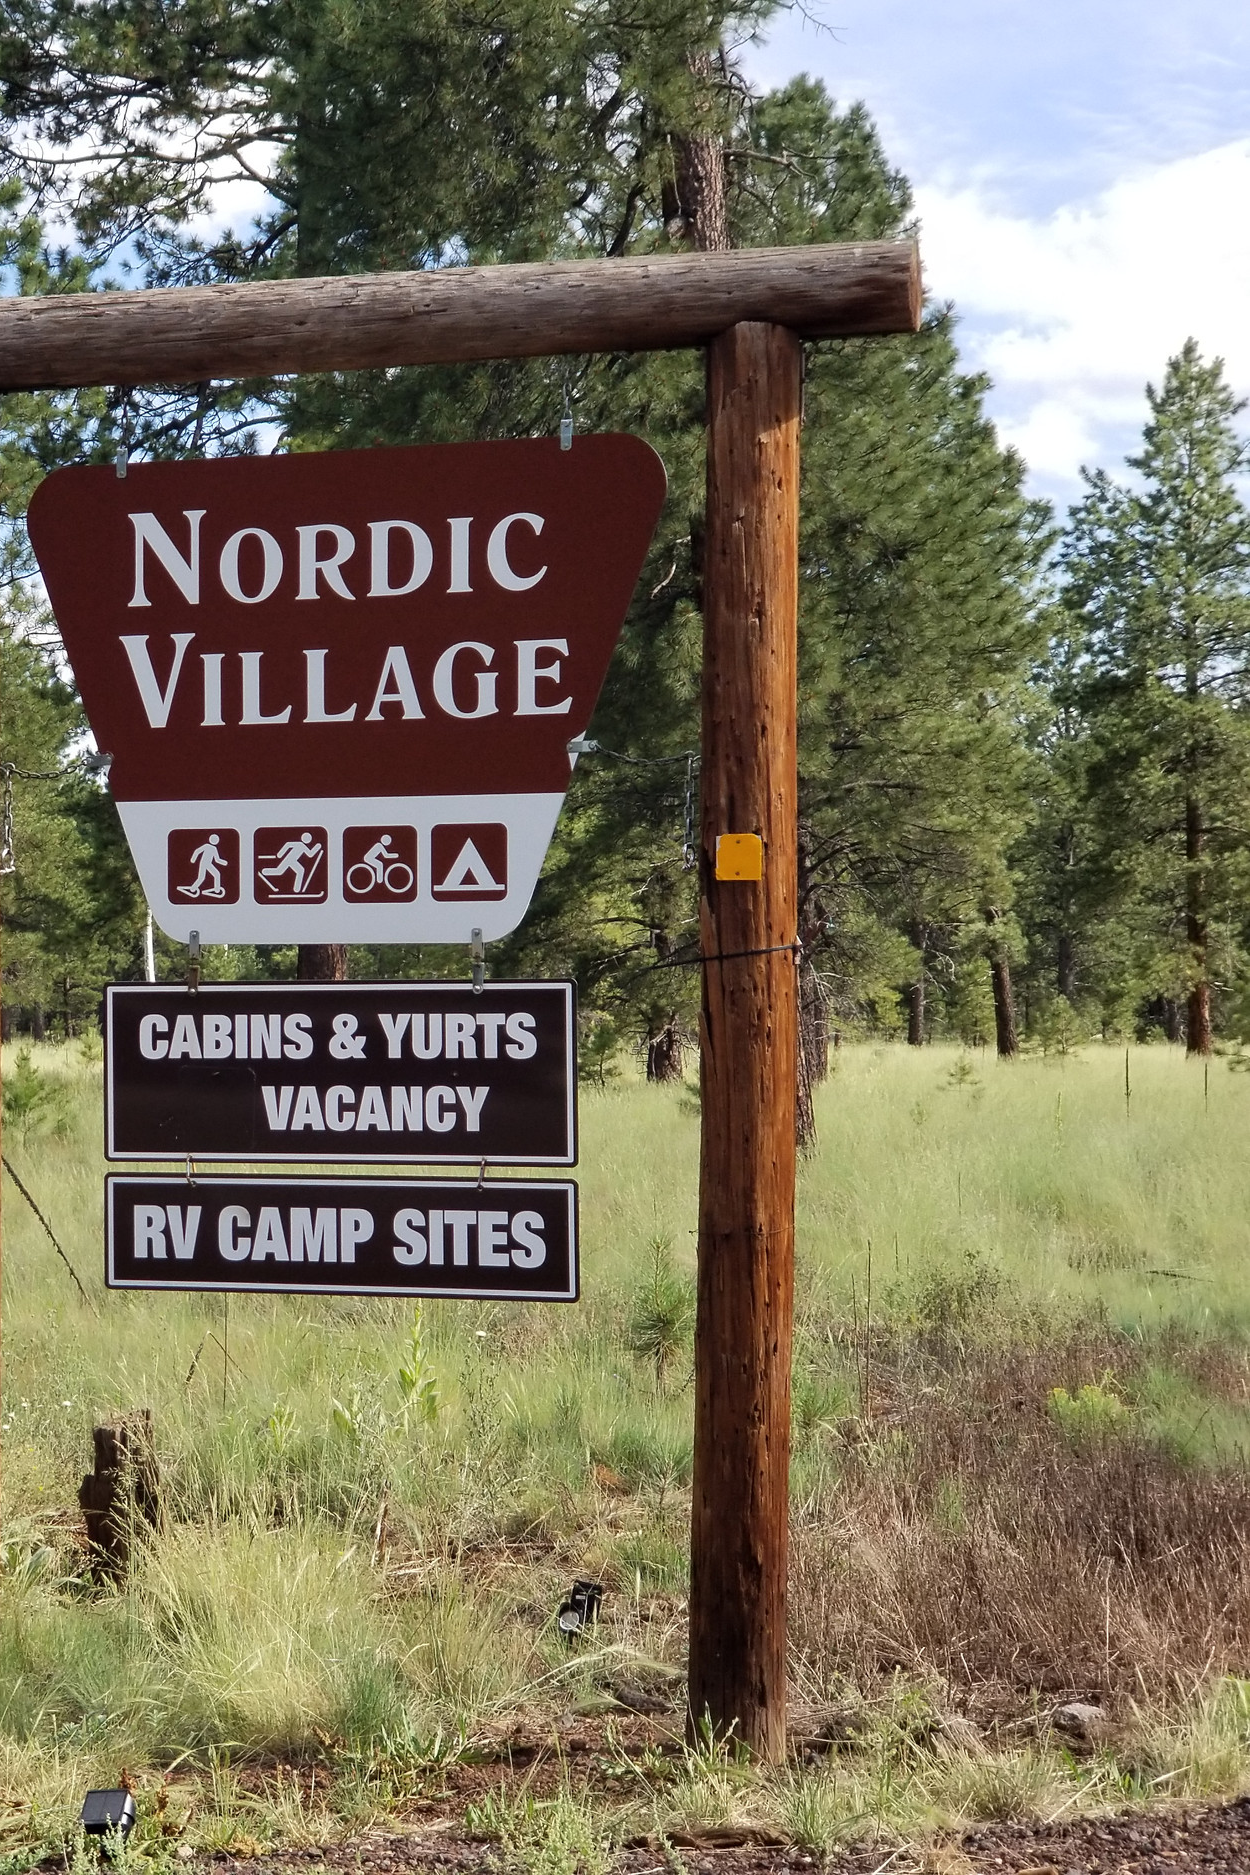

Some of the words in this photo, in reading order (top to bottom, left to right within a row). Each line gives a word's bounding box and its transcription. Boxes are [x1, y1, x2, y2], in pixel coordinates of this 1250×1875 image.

[128, 510, 547, 607] NORDIC
[119, 633, 572, 728] VILLAGE
[140, 1014, 313, 1059] CABINS
[329, 1014, 366, 1059] &
[378, 1013, 537, 1059] YURTS
[262, 1085, 489, 1132] VACANCY
[134, 1205, 201, 1259] RV
[219, 1206, 374, 1262] CAMP
[393, 1209, 546, 1268] SITES
